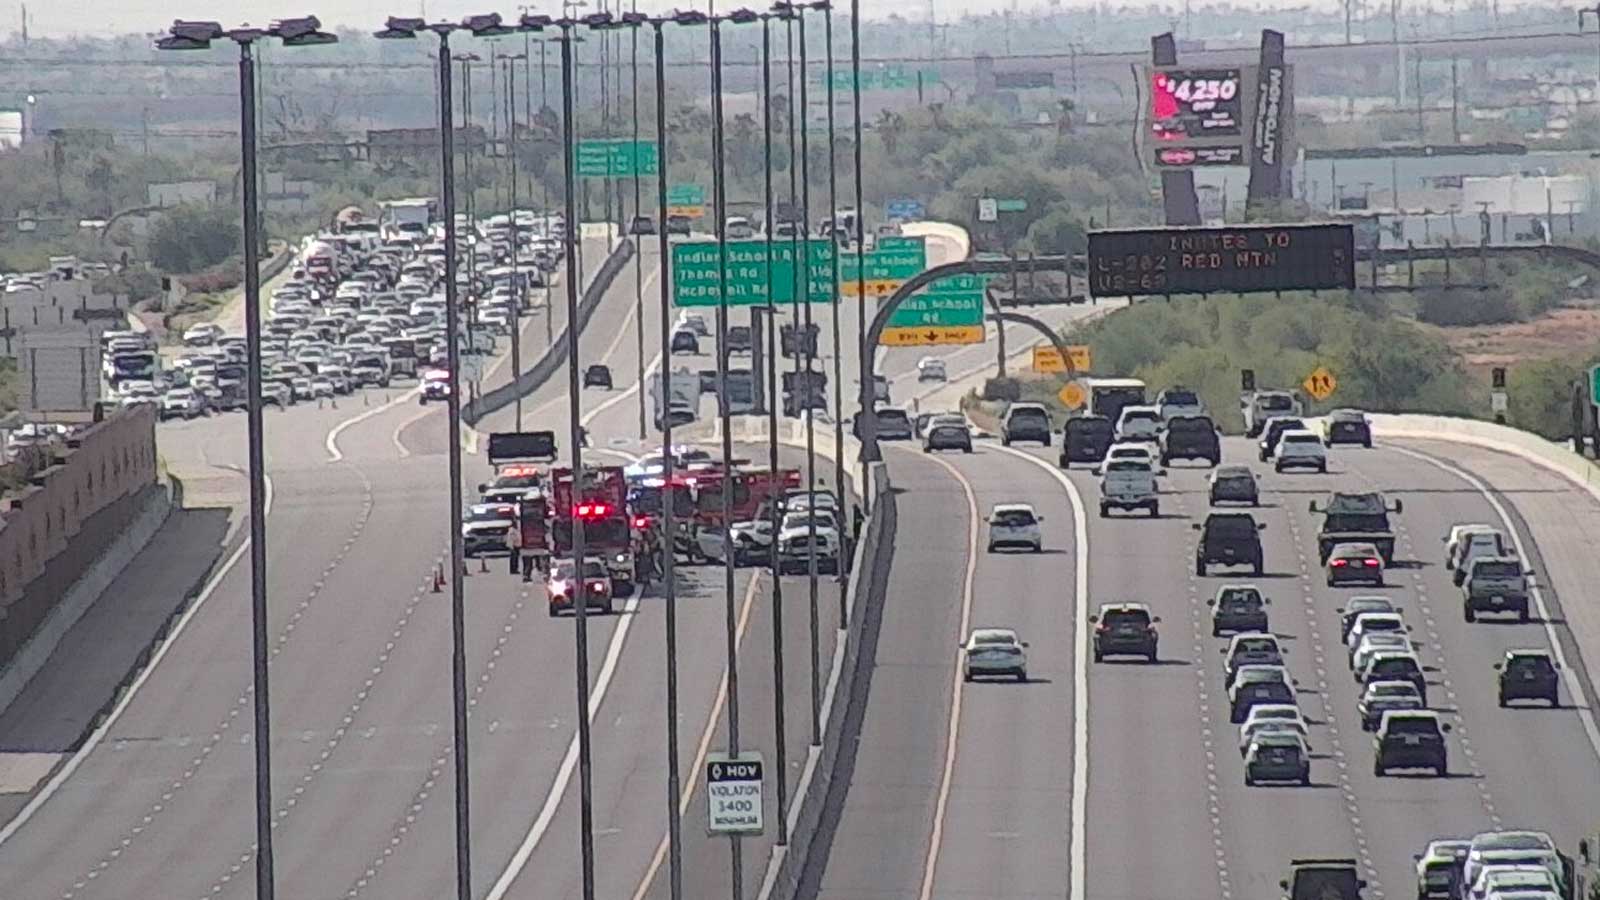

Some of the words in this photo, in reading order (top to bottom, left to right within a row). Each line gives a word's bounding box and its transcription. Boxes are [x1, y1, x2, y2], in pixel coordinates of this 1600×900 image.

[1182, 252, 1222, 269] RED
[1237, 250, 1278, 268] MTN
[680, 268, 733, 281] Thoms
[740, 267, 758, 279] Rd
[680, 284, 746, 297] McDoell
[726, 765, 757, 777] HOV
